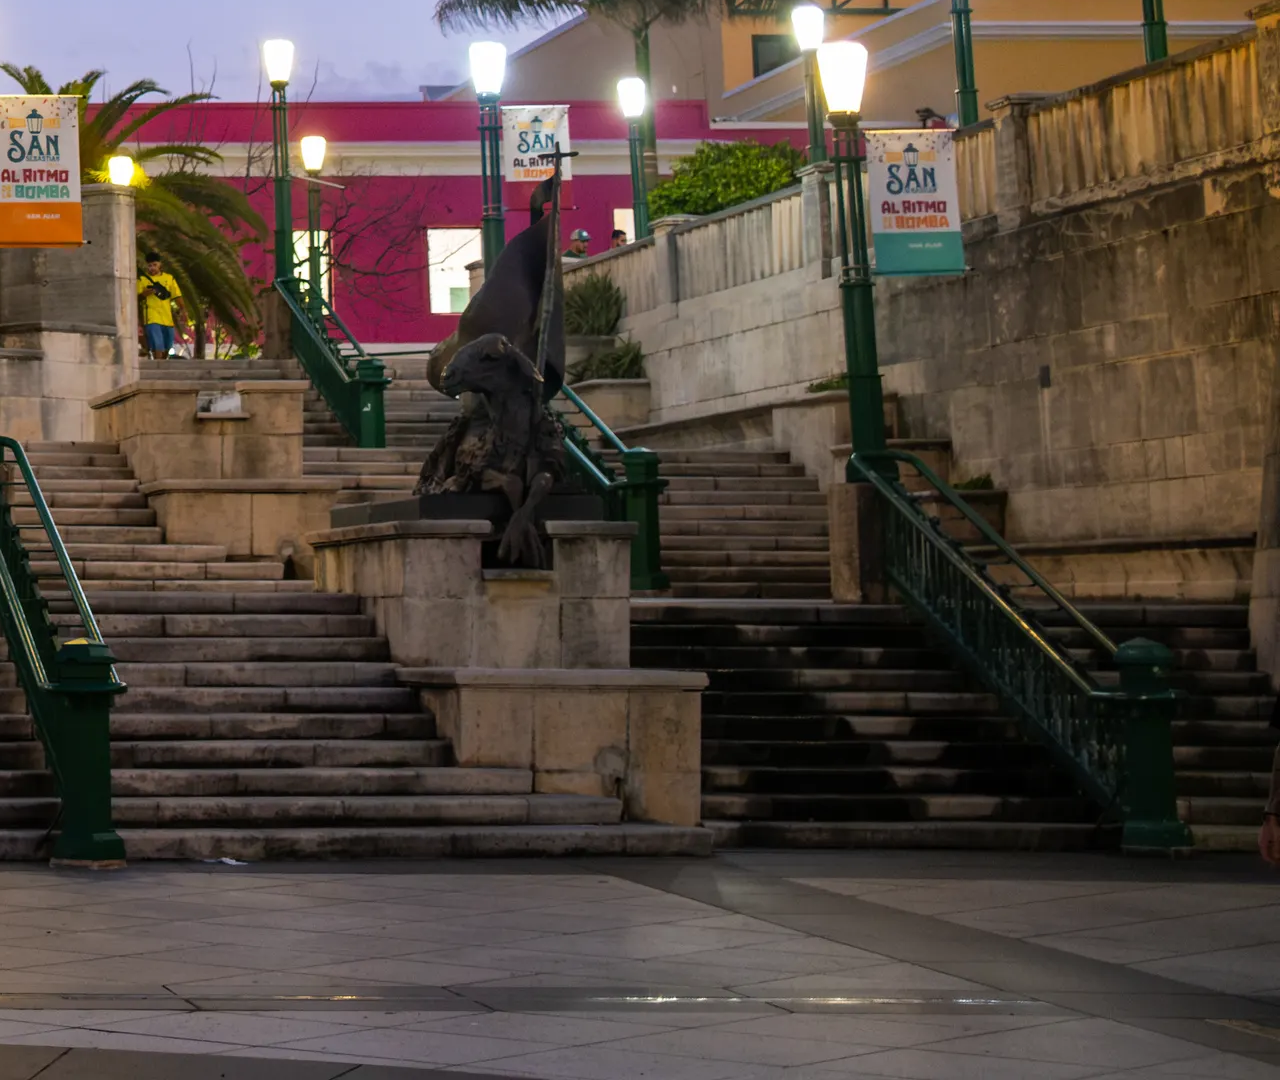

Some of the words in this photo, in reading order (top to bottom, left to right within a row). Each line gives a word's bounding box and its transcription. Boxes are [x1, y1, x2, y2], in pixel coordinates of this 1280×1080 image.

[7, 130, 60, 163] SAN
[517, 131, 555, 153] SAN
[513, 158, 528, 168] AL
[1, 169, 20, 183] AL
[22, 168, 69, 183] RITMO
[886, 163, 936, 195] SAN
[15, 185, 70, 199] BOMBA
[881, 200, 899, 214] AL
[902, 200, 947, 214] RITMO
[895, 215, 949, 230] BOMBA
